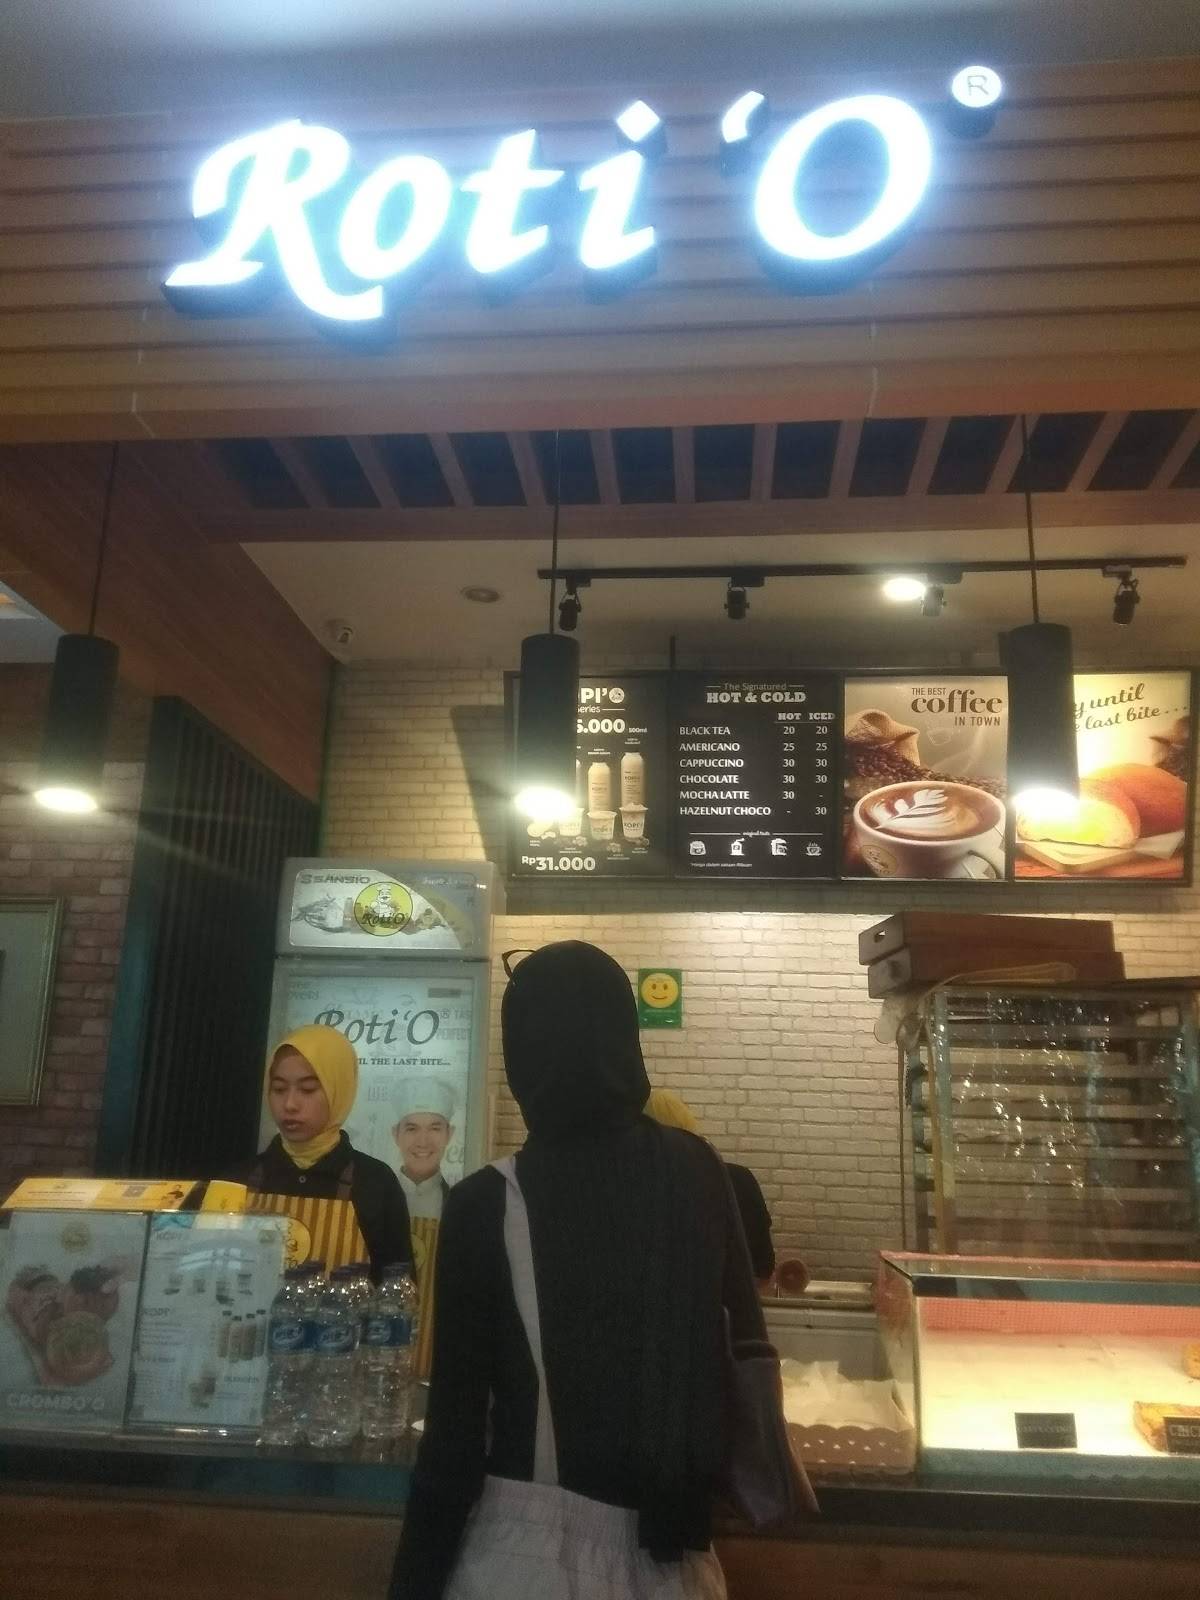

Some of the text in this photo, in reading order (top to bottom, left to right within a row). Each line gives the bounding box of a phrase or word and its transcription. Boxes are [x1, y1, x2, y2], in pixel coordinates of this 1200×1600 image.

[724, 682, 787, 692] The Signatured
[911, 687, 947, 696] THE BEST
[706, 691, 806, 703] HOT & COLD
[910, 688, 1003, 714] coffee
[1089, 683, 1145, 709] until
[777, 712, 835, 721] HOT ICED
[954, 716, 1001, 727] IN TOWN
[1085, 713, 1122, 730] last
[680, 726, 828, 735] BLACK TEA 20 20
[679, 742, 828, 751] AMERICANO 25 25
[679, 758, 828, 767] CAPPUCCINO 30 30
[679, 774, 828, 784] CHOCOLATE 30 30
[679, 790, 718, 800] MOCHA
[720, 790, 750, 800] LATTE
[783, 790, 795, 800] 30
[679, 806, 733, 816] HAZELNUT
[734, 806, 772, 816] CHOCO
[815, 806, 828, 816] 30
[521, 855, 596, 871] Rp31.000
[371, 1057, 391, 1066] THE
[393, 1057, 418, 1066] LAST
